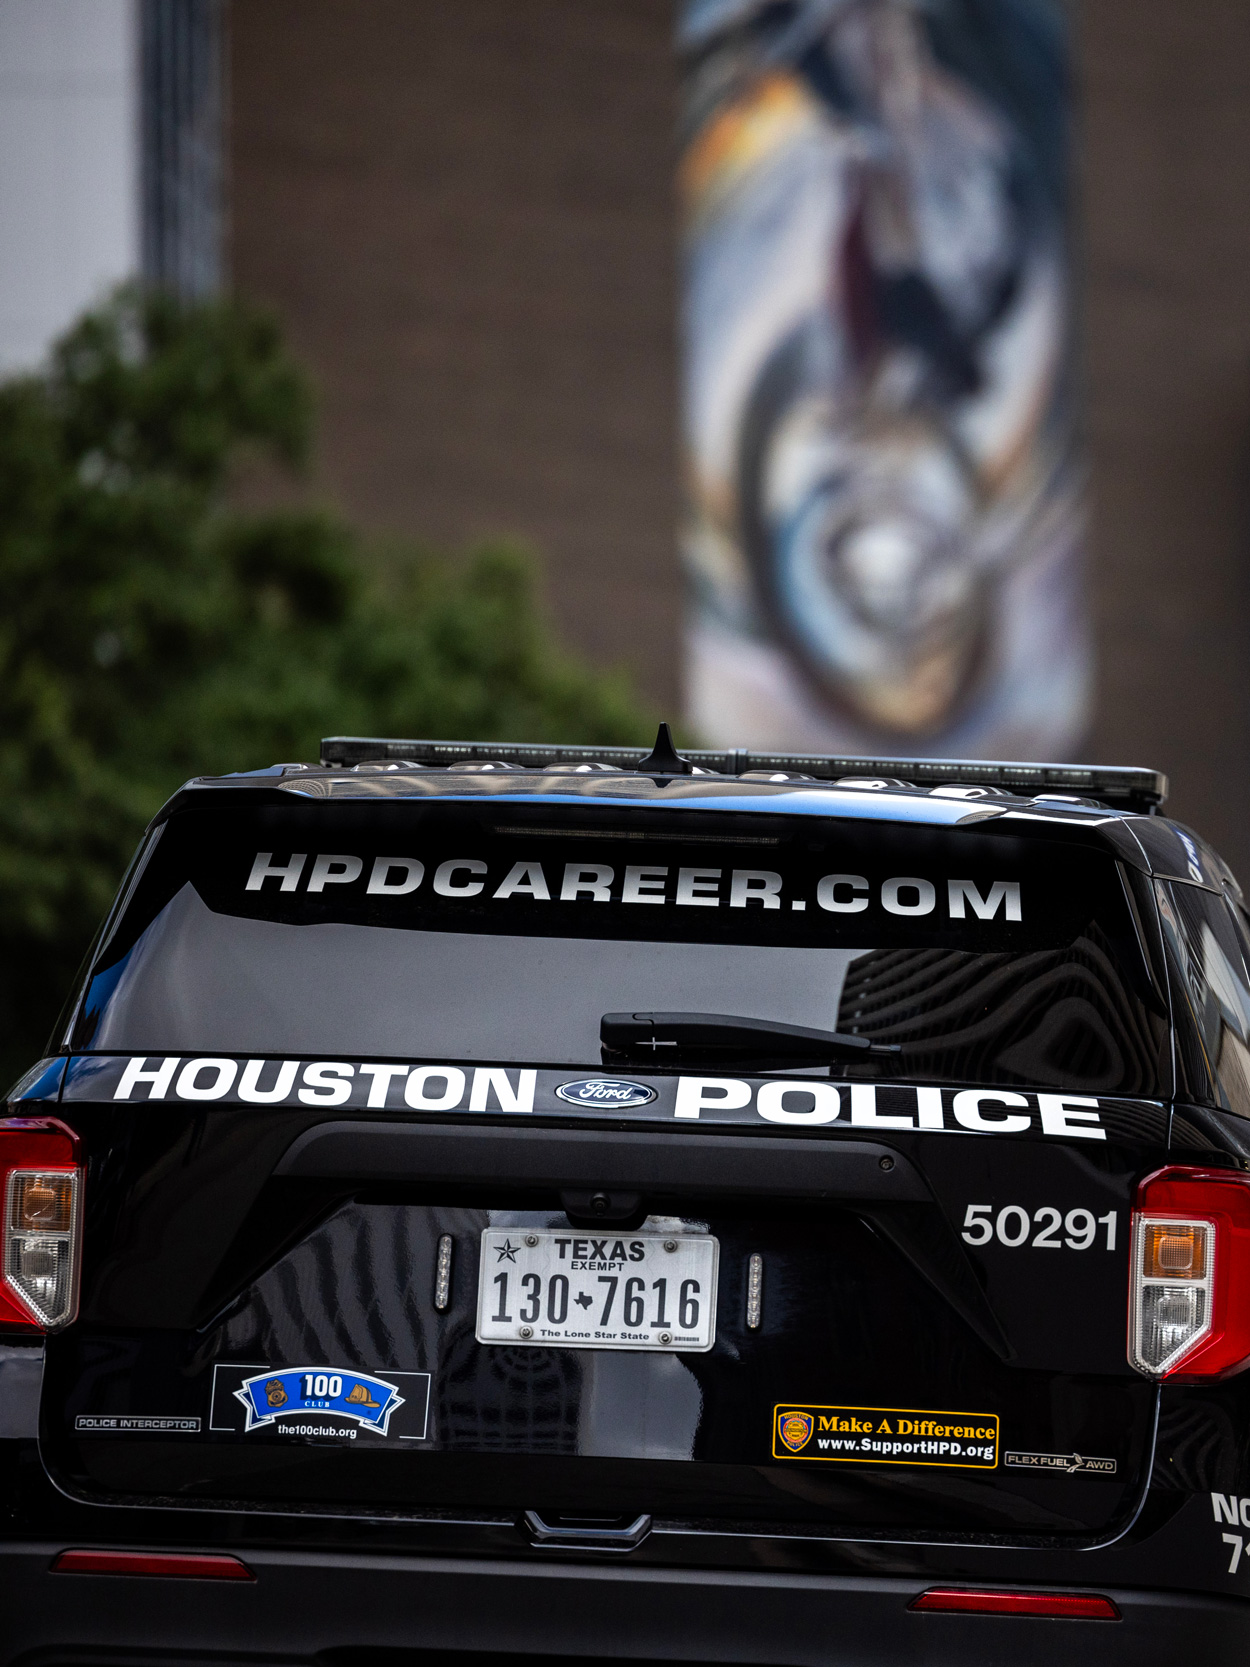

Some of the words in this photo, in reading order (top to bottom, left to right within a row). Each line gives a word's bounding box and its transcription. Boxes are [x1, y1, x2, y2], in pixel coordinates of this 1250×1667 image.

[244, 851, 1022, 922] HPDCAREER.COM
[113, 1056, 537, 1113] HOUSTON
[673, 1076, 1107, 1140] POLICE
[579, 1082, 633, 1100] Ford
[961, 1204, 1117, 1250] 50291
[554, 1238, 645, 1262] TEXAS
[570, 1260, 625, 1272] EXEMPT
[491, 1272, 570, 1324] 130
[597, 1276, 701, 1329] 7616
[540, 1329, 561, 1337] The
[564, 1330, 591, 1338] Lone
[594, 1331, 618, 1339] Star
[620, 1332, 650, 1340] State
[304, 1374, 343, 1398] 100
[304, 1400, 330, 1408] CLUB
[79, 1419, 117, 1427] POLICE
[120, 1420, 197, 1429] INTERCEPTOR
[277, 1424, 357, 1440] the100club.org
[817, 1415, 873, 1433] Make
[876, 1418, 891, 1434] A
[896, 1419, 996, 1440] Difference
[817, 1438, 994, 1460] www.SupportHPD.org
[1008, 1455, 1039, 1465] FLEX
[1040, 1457, 1070, 1467] FUEL
[1085, 1460, 1113, 1470] AWD
